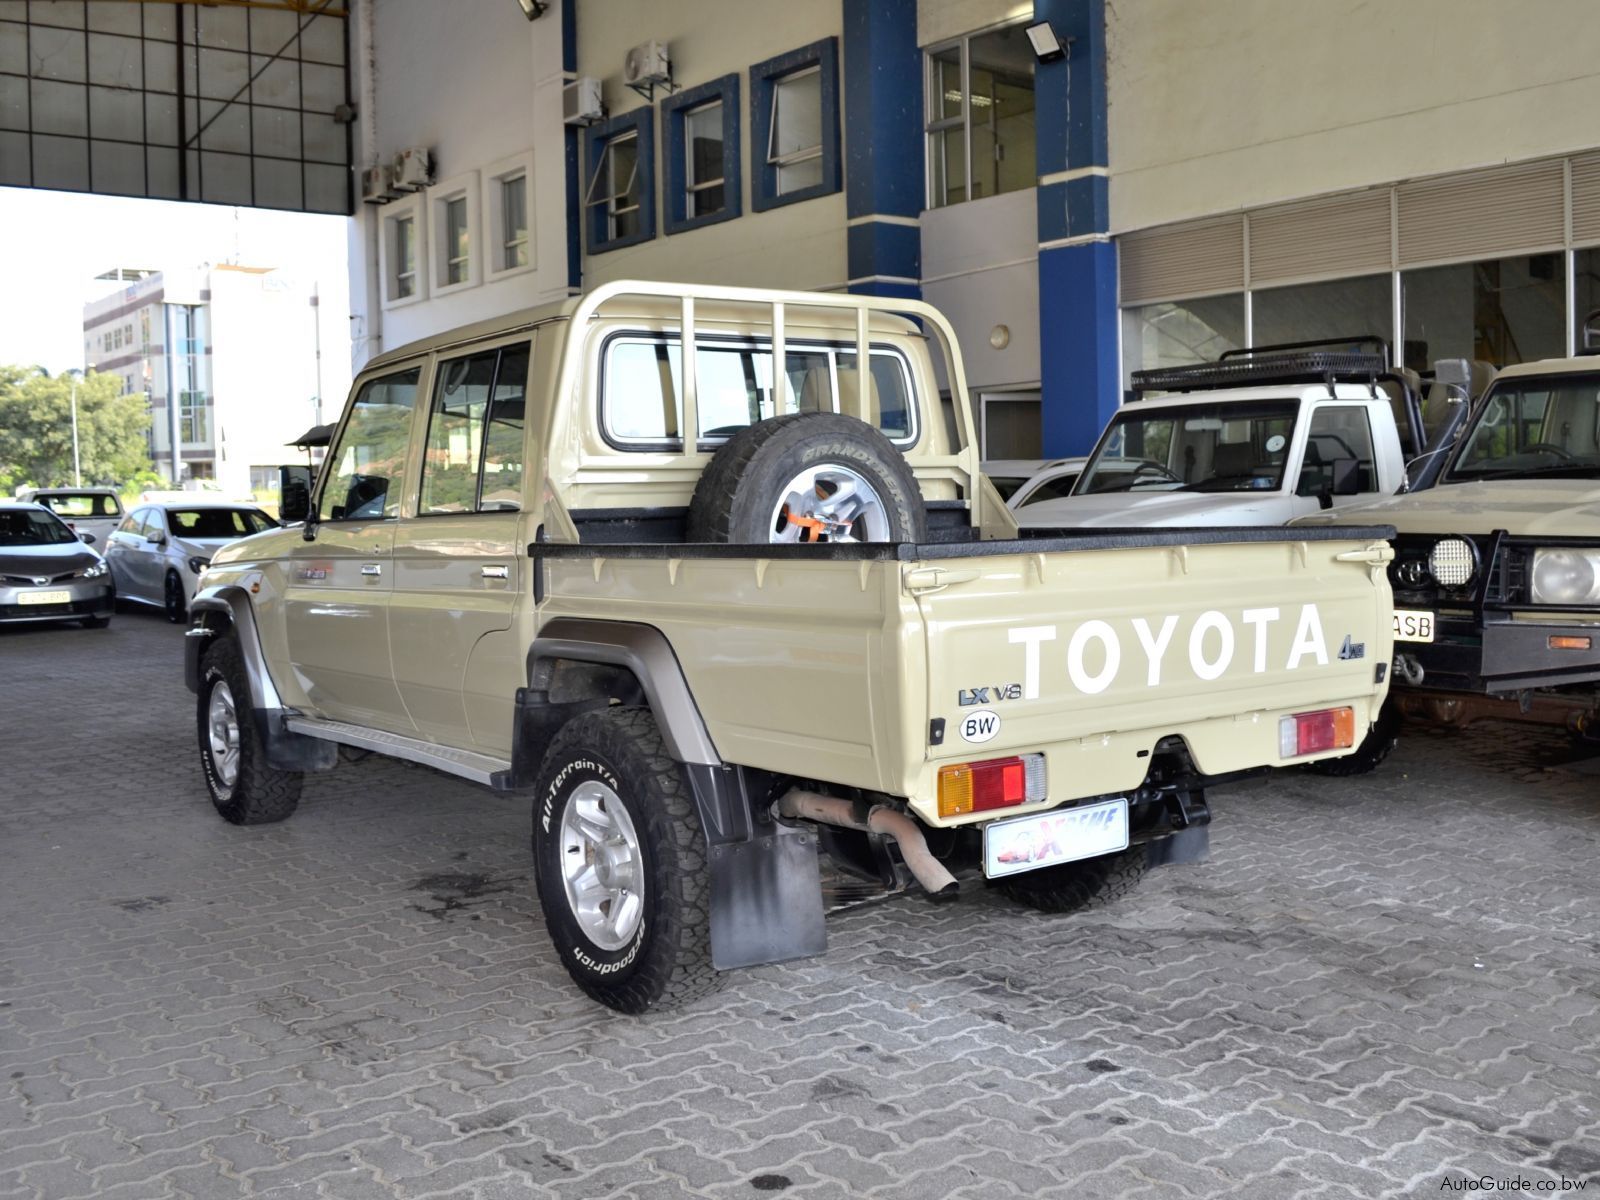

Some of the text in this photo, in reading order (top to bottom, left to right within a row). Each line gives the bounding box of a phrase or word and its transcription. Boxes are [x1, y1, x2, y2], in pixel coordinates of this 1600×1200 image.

[802, 443, 904, 502] GRANDTREK
[1393, 615, 1431, 638] ASB
[1009, 604, 1329, 699] TOYOTA
[959, 683, 1022, 706] LX V8
[966, 717, 995, 736] BW
[541, 758, 619, 834] All-Terrain T/A
